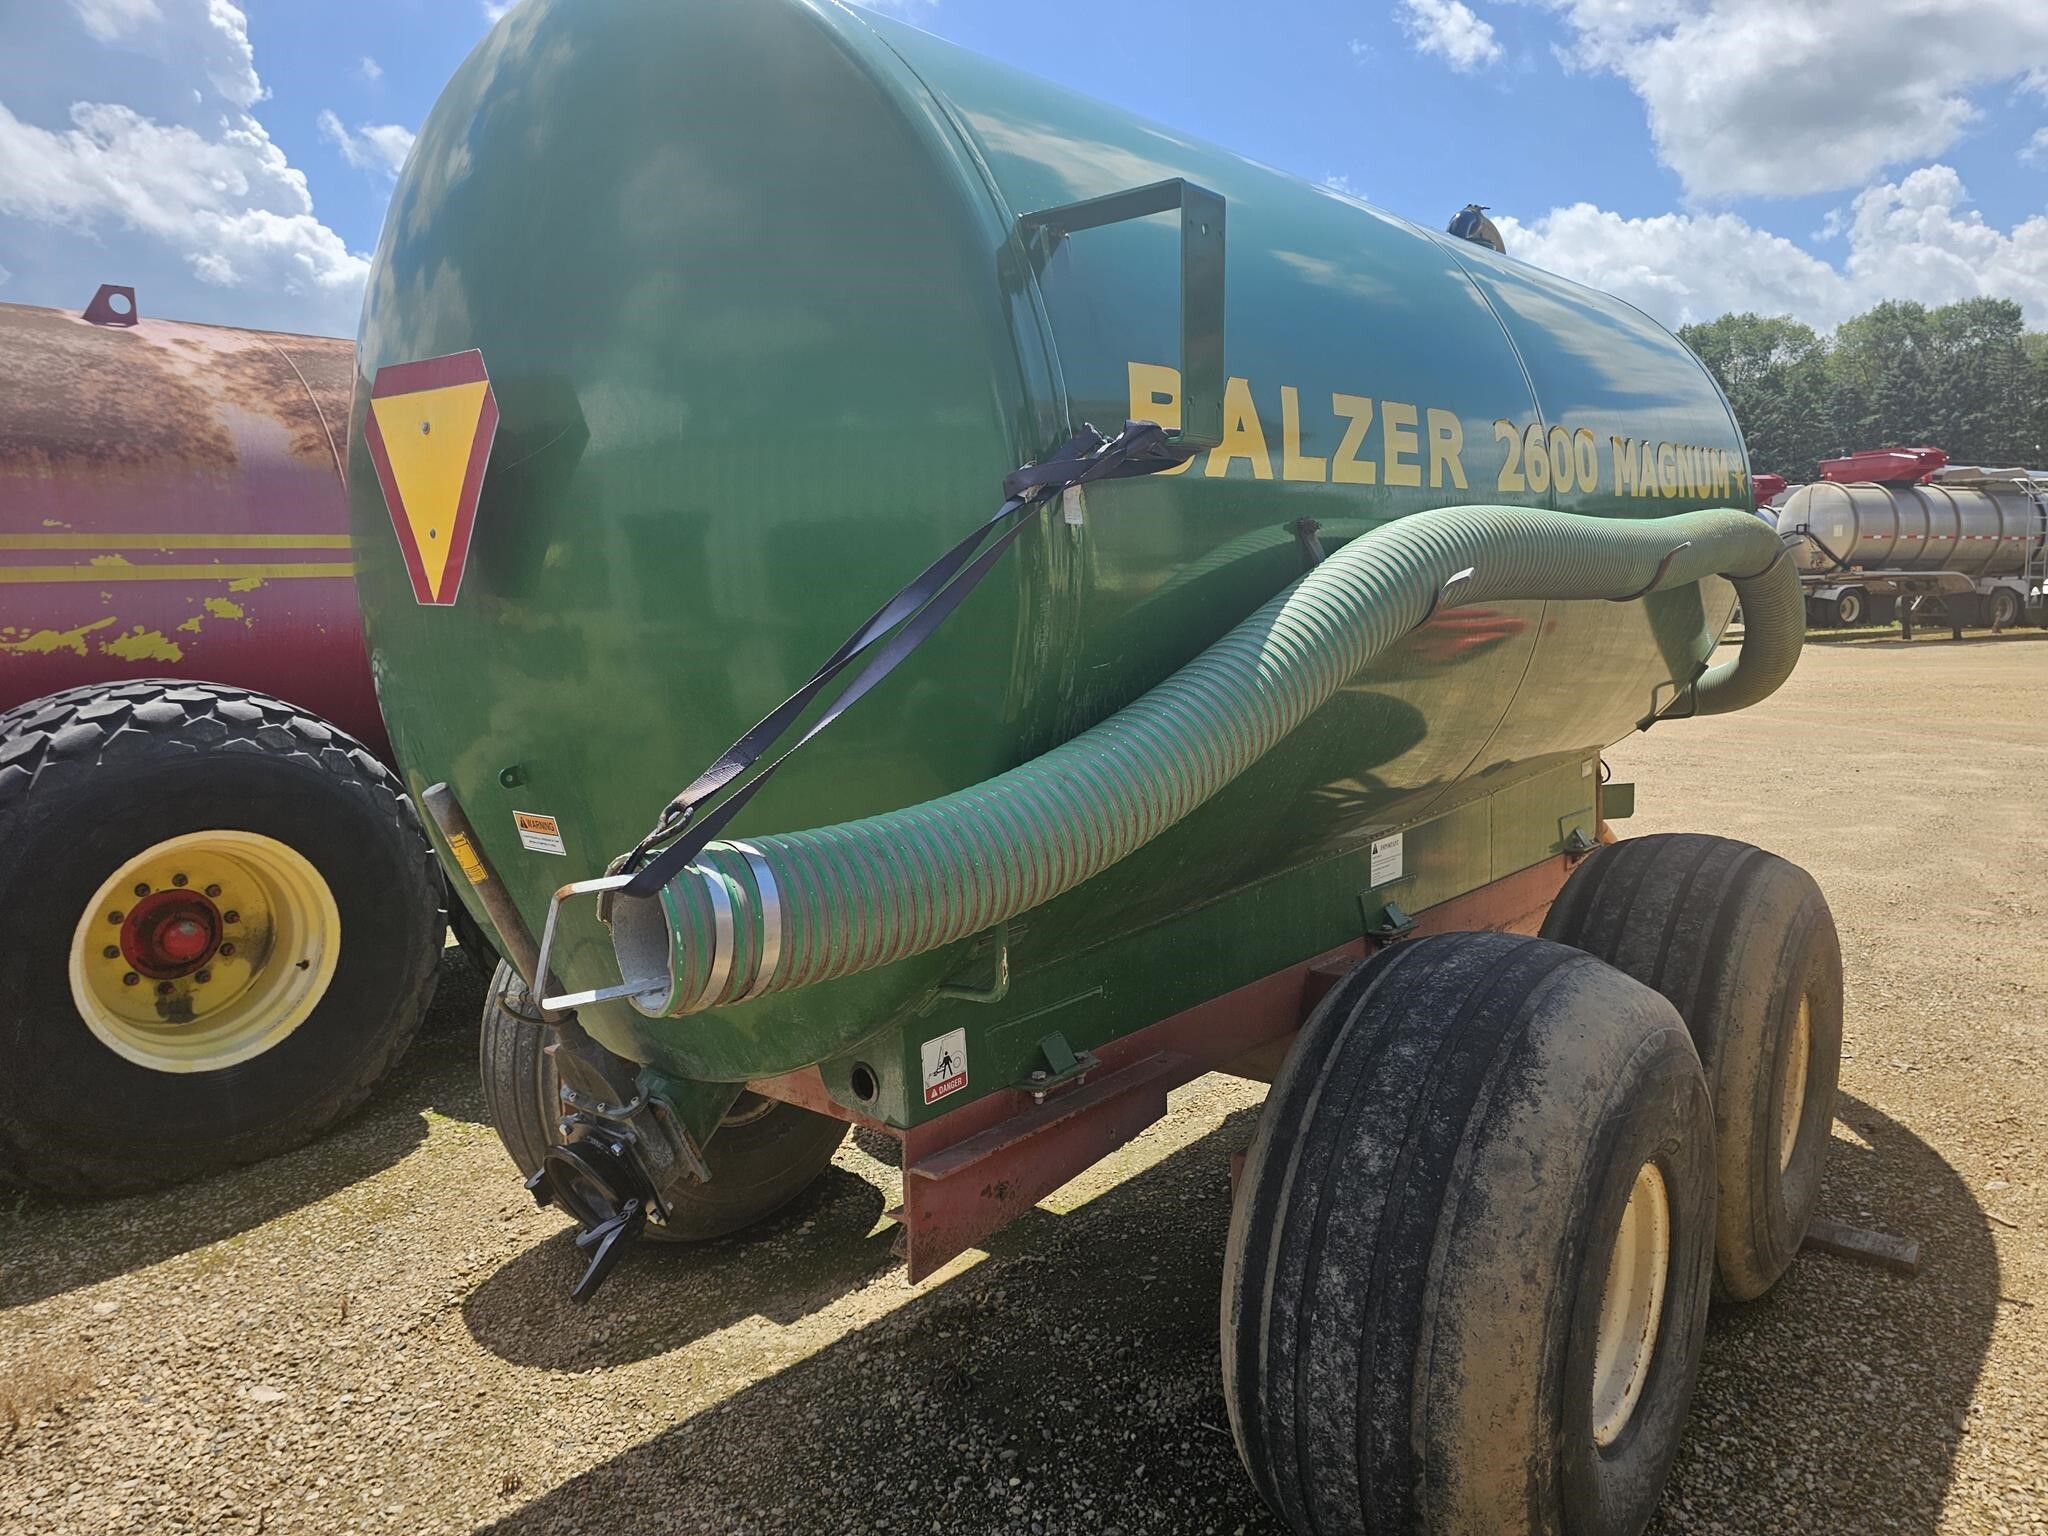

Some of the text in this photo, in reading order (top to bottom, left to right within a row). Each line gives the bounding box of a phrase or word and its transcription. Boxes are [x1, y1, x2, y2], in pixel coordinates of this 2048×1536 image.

[1493, 418, 1598, 494] 2600
[1609, 436, 1730, 499] MAGNUM
[527, 818, 555, 832] WARNING
[939, 1077, 962, 1094] DANGER
